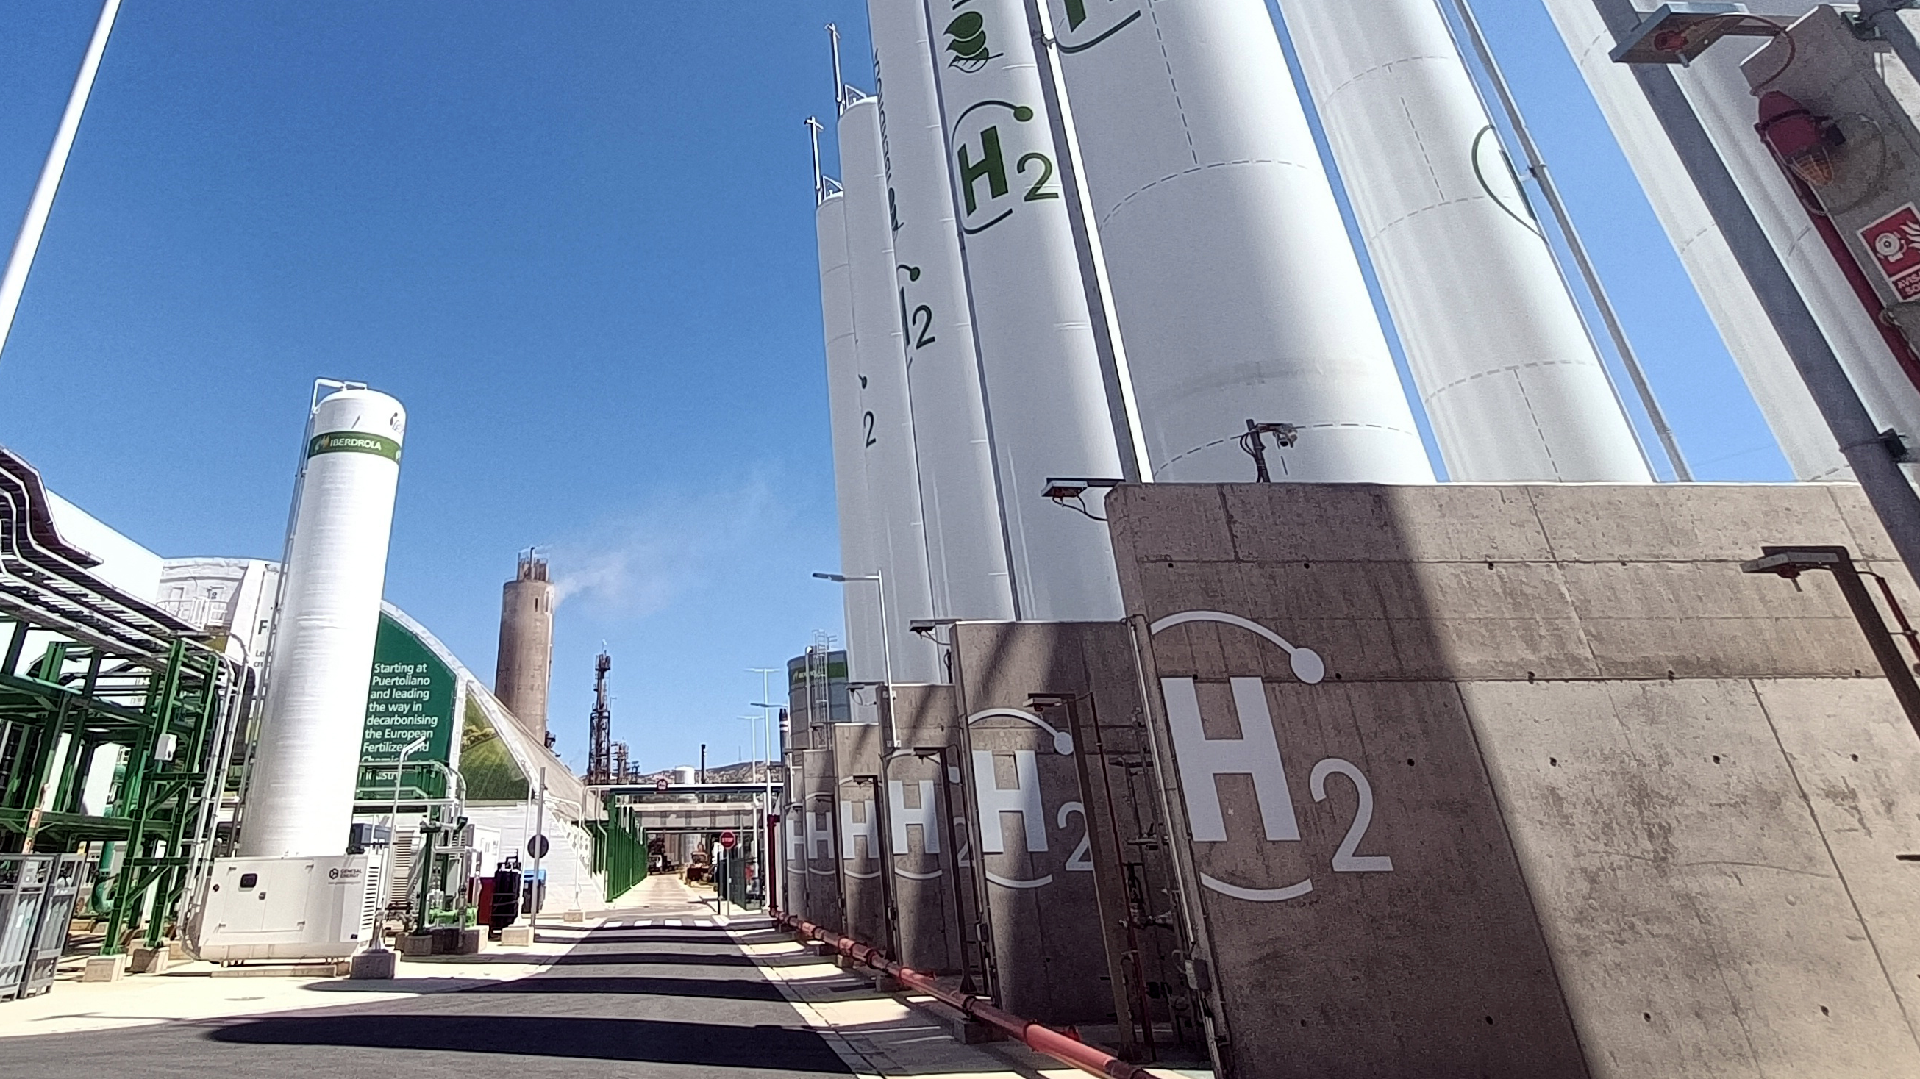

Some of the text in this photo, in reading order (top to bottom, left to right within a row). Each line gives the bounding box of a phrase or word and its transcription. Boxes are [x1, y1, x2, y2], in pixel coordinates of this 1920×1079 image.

[330, 438, 382, 451] IBERDROLA
[374, 663, 427, 675] Starting at
[372, 676, 430, 686] Puertollano
[370, 688, 430, 701] and leading
[368, 701, 422, 714] the way in
[366, 714, 439, 727] decarbonising
[365, 728, 433, 741] the European
